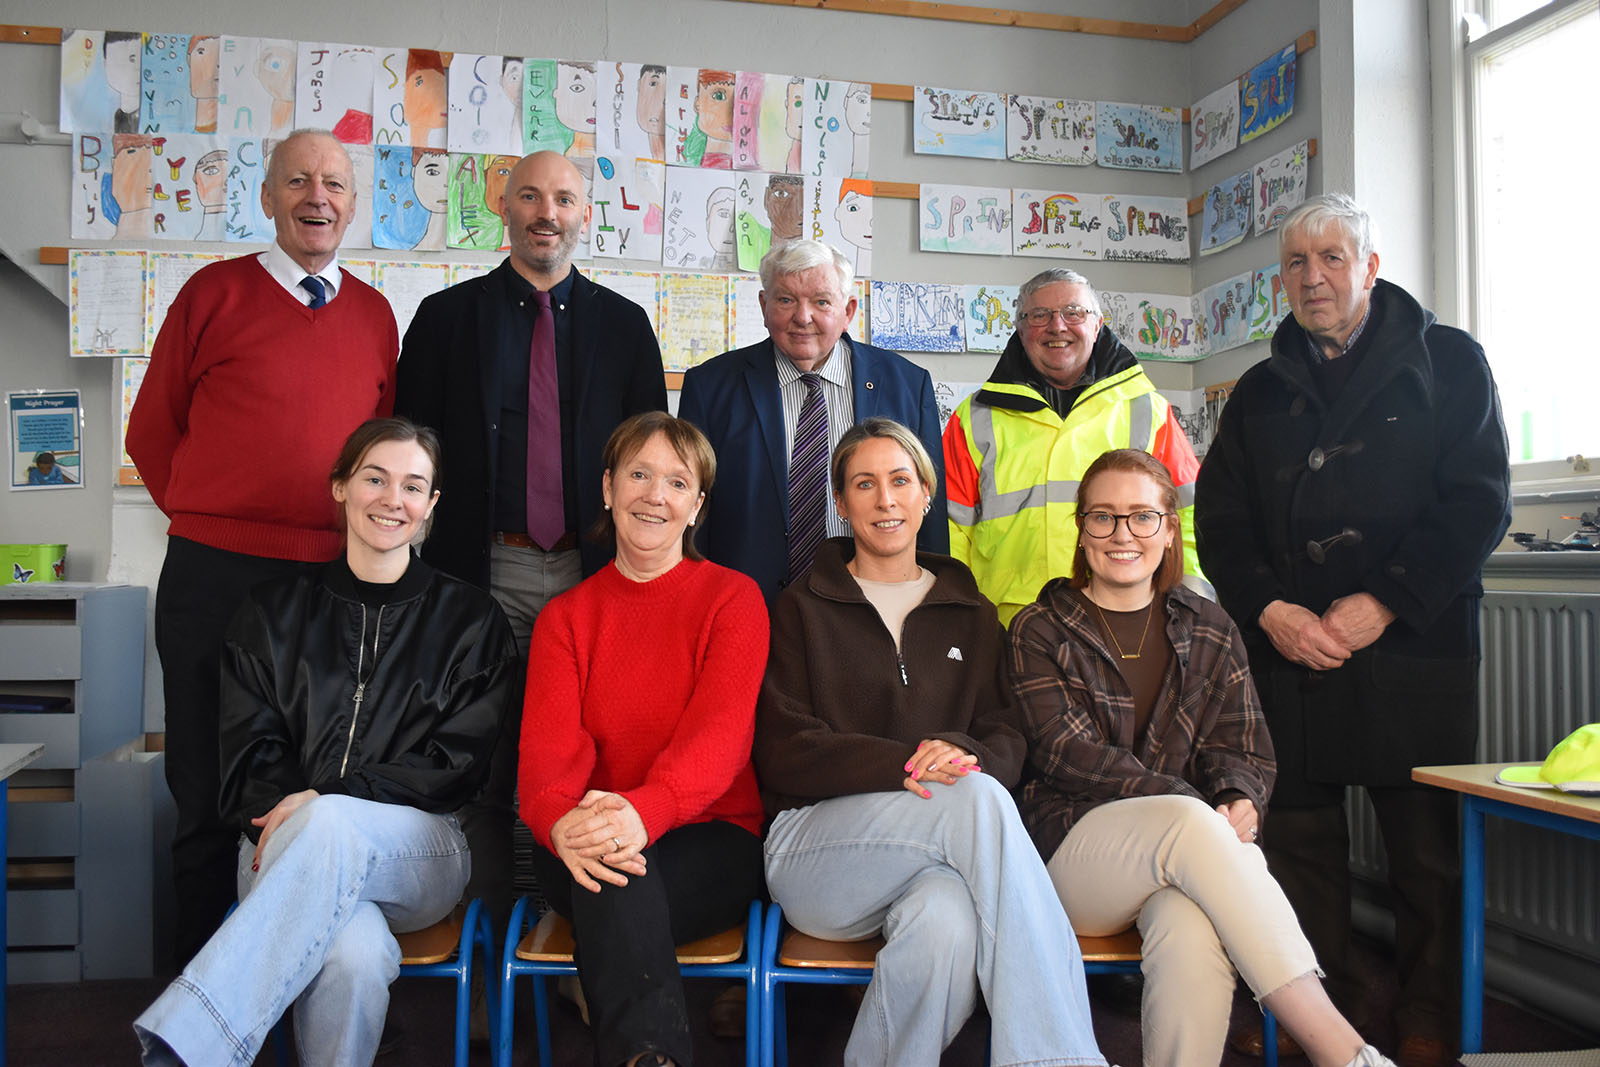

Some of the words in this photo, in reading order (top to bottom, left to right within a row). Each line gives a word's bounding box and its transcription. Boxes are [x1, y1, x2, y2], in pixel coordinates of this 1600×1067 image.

[152, 137, 192, 233] TYLER
[456, 156, 479, 246] ALEX
[1107, 201, 1188, 242] SPRING
